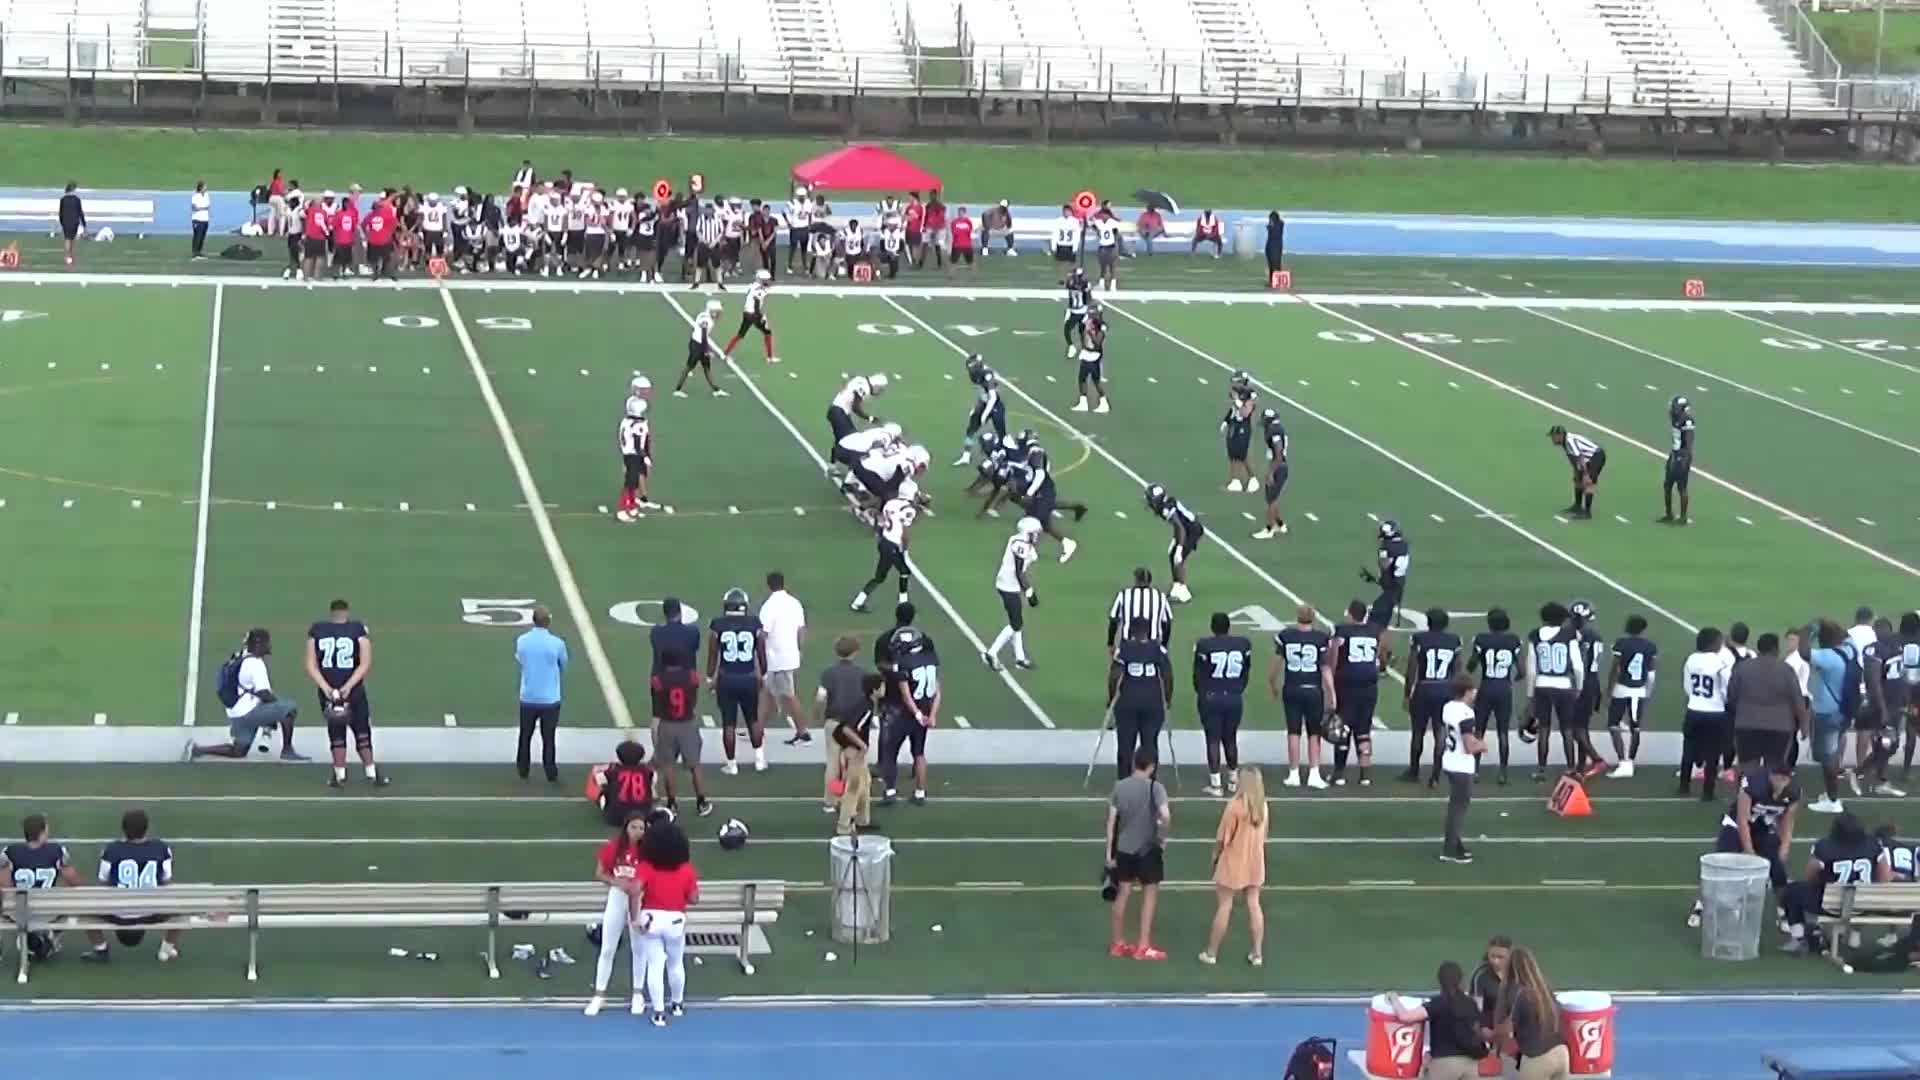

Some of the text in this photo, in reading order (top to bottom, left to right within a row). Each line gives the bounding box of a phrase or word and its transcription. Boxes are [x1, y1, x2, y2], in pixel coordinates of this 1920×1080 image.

[319, 636, 354, 669] 72
[720, 630, 754, 662] 33
[1286, 643, 1318, 673] 52
[1210, 650, 1243, 678] 76
[1425, 649, 1454, 678] 17
[1485, 649, 1513, 678] 12
[1627, 653, 1645, 680] 4
[1691, 673, 1714, 699] 29
[669, 686, 685, 718] 9
[617, 770, 644, 801] 78
[117, 859, 158, 888] 94
[1833, 858, 1872, 886] 73
